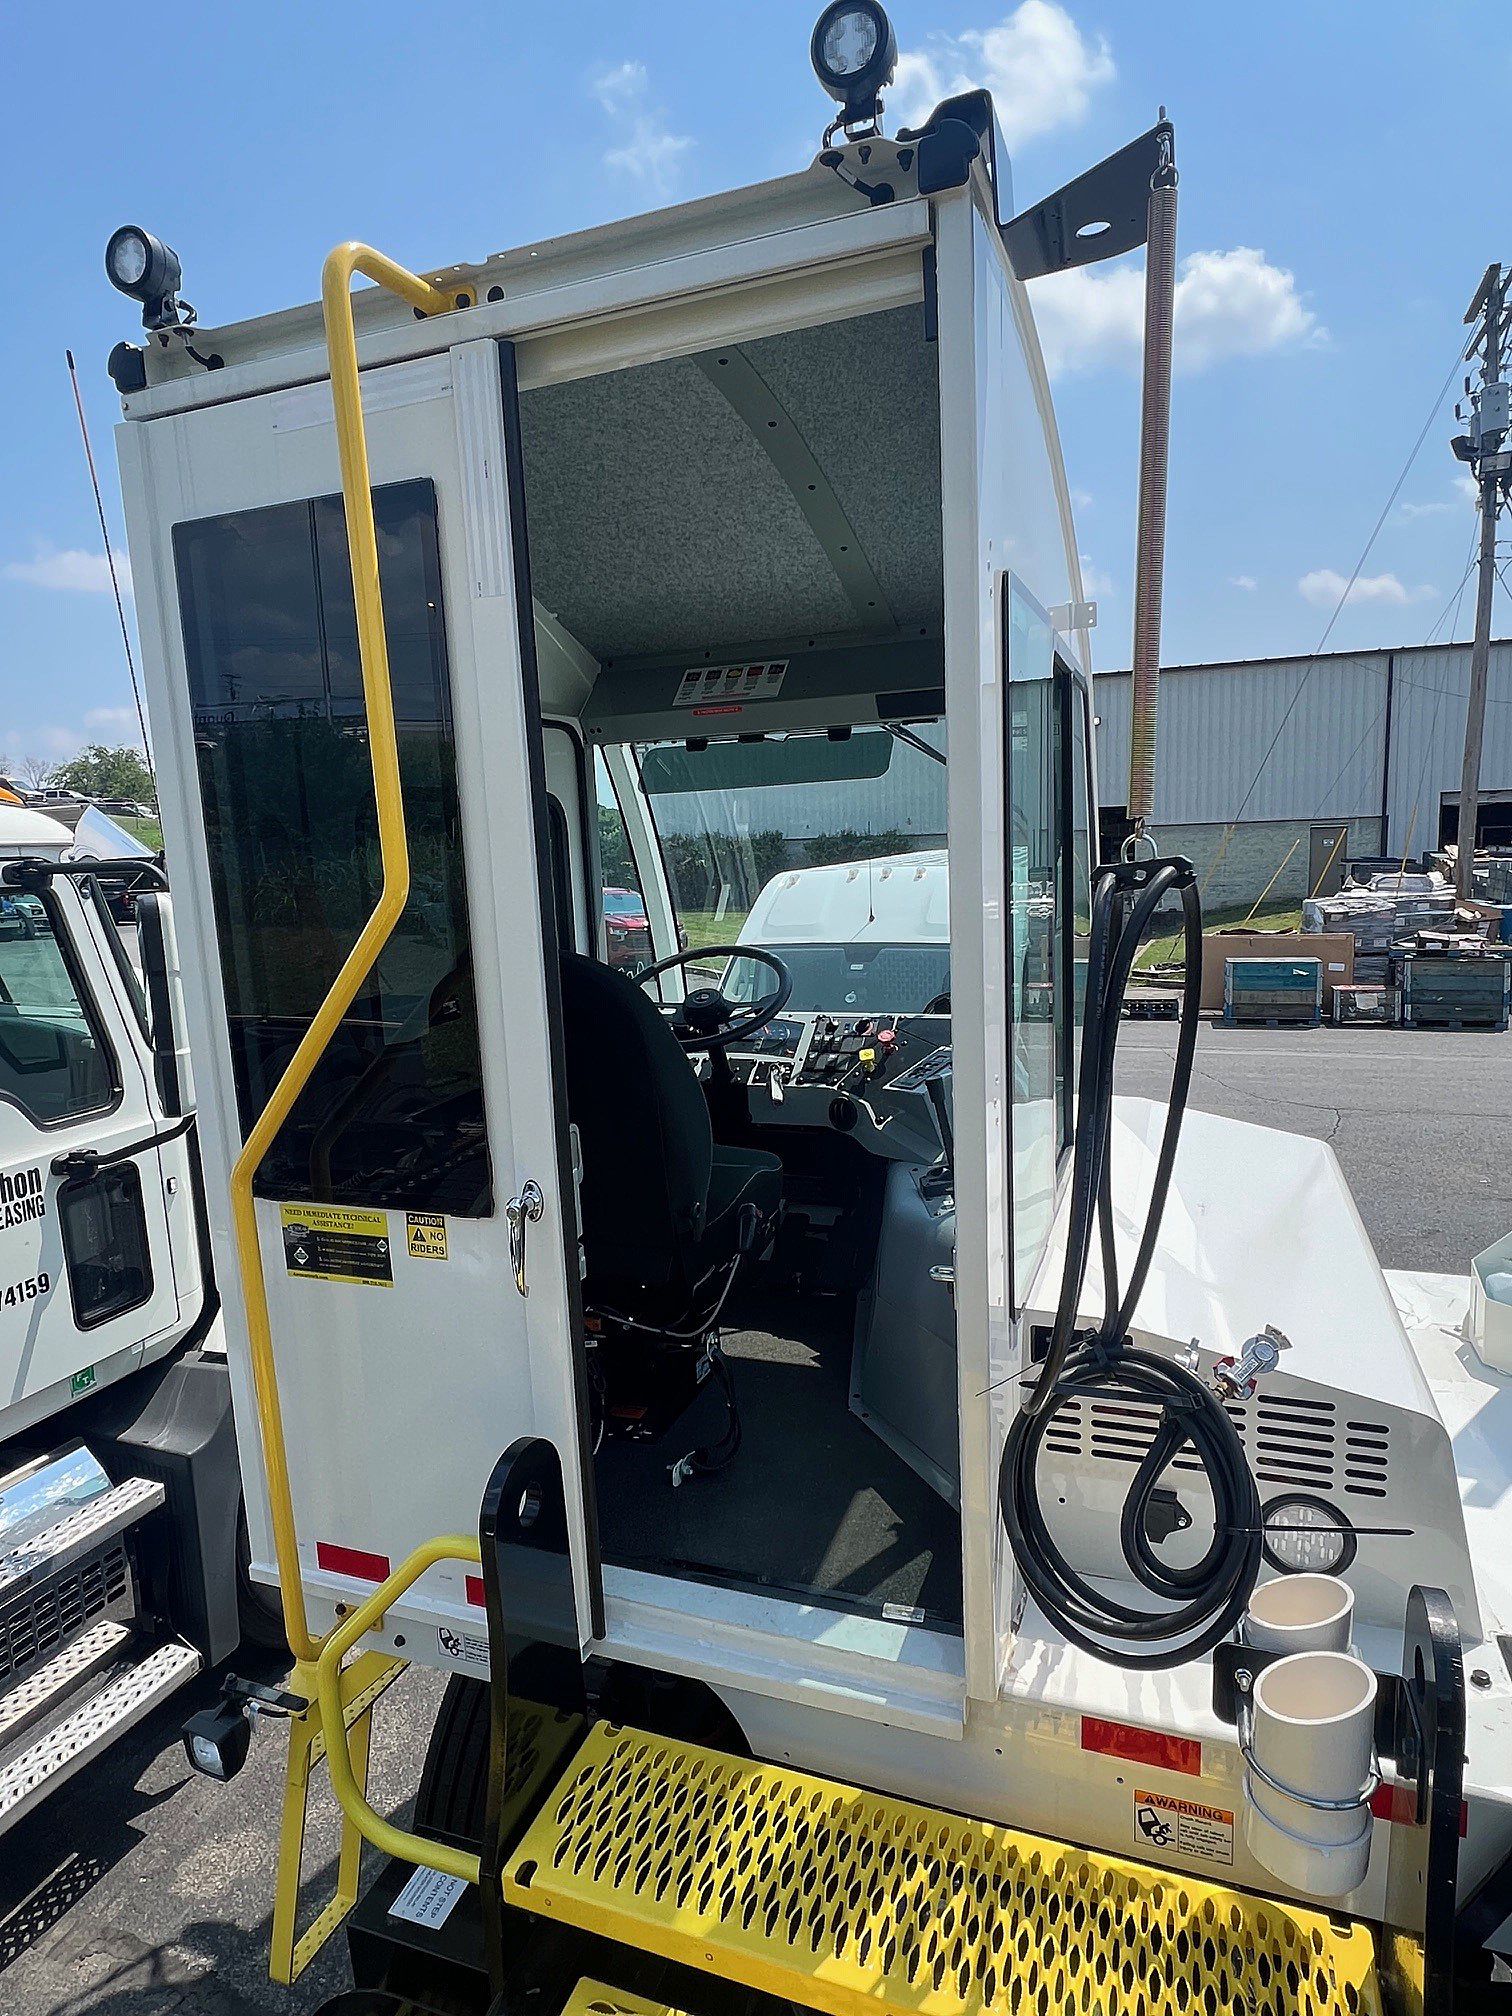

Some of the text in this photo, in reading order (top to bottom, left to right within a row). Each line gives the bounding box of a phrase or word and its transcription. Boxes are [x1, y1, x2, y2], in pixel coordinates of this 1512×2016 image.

[284, 1208, 381, 1224] NEED IMMEDIATE TECHNICAL
[408, 1215, 443, 1226] CAUTION
[430, 1231, 444, 1241] NO
[410, 1243, 445, 1256] RIDERS
[0, 1272, 50, 1312] 4159
[1156, 1796, 1224, 1821] WARNING
[415, 1874, 448, 1918] CONTENTS
[431, 1896, 447, 1919] STEP
